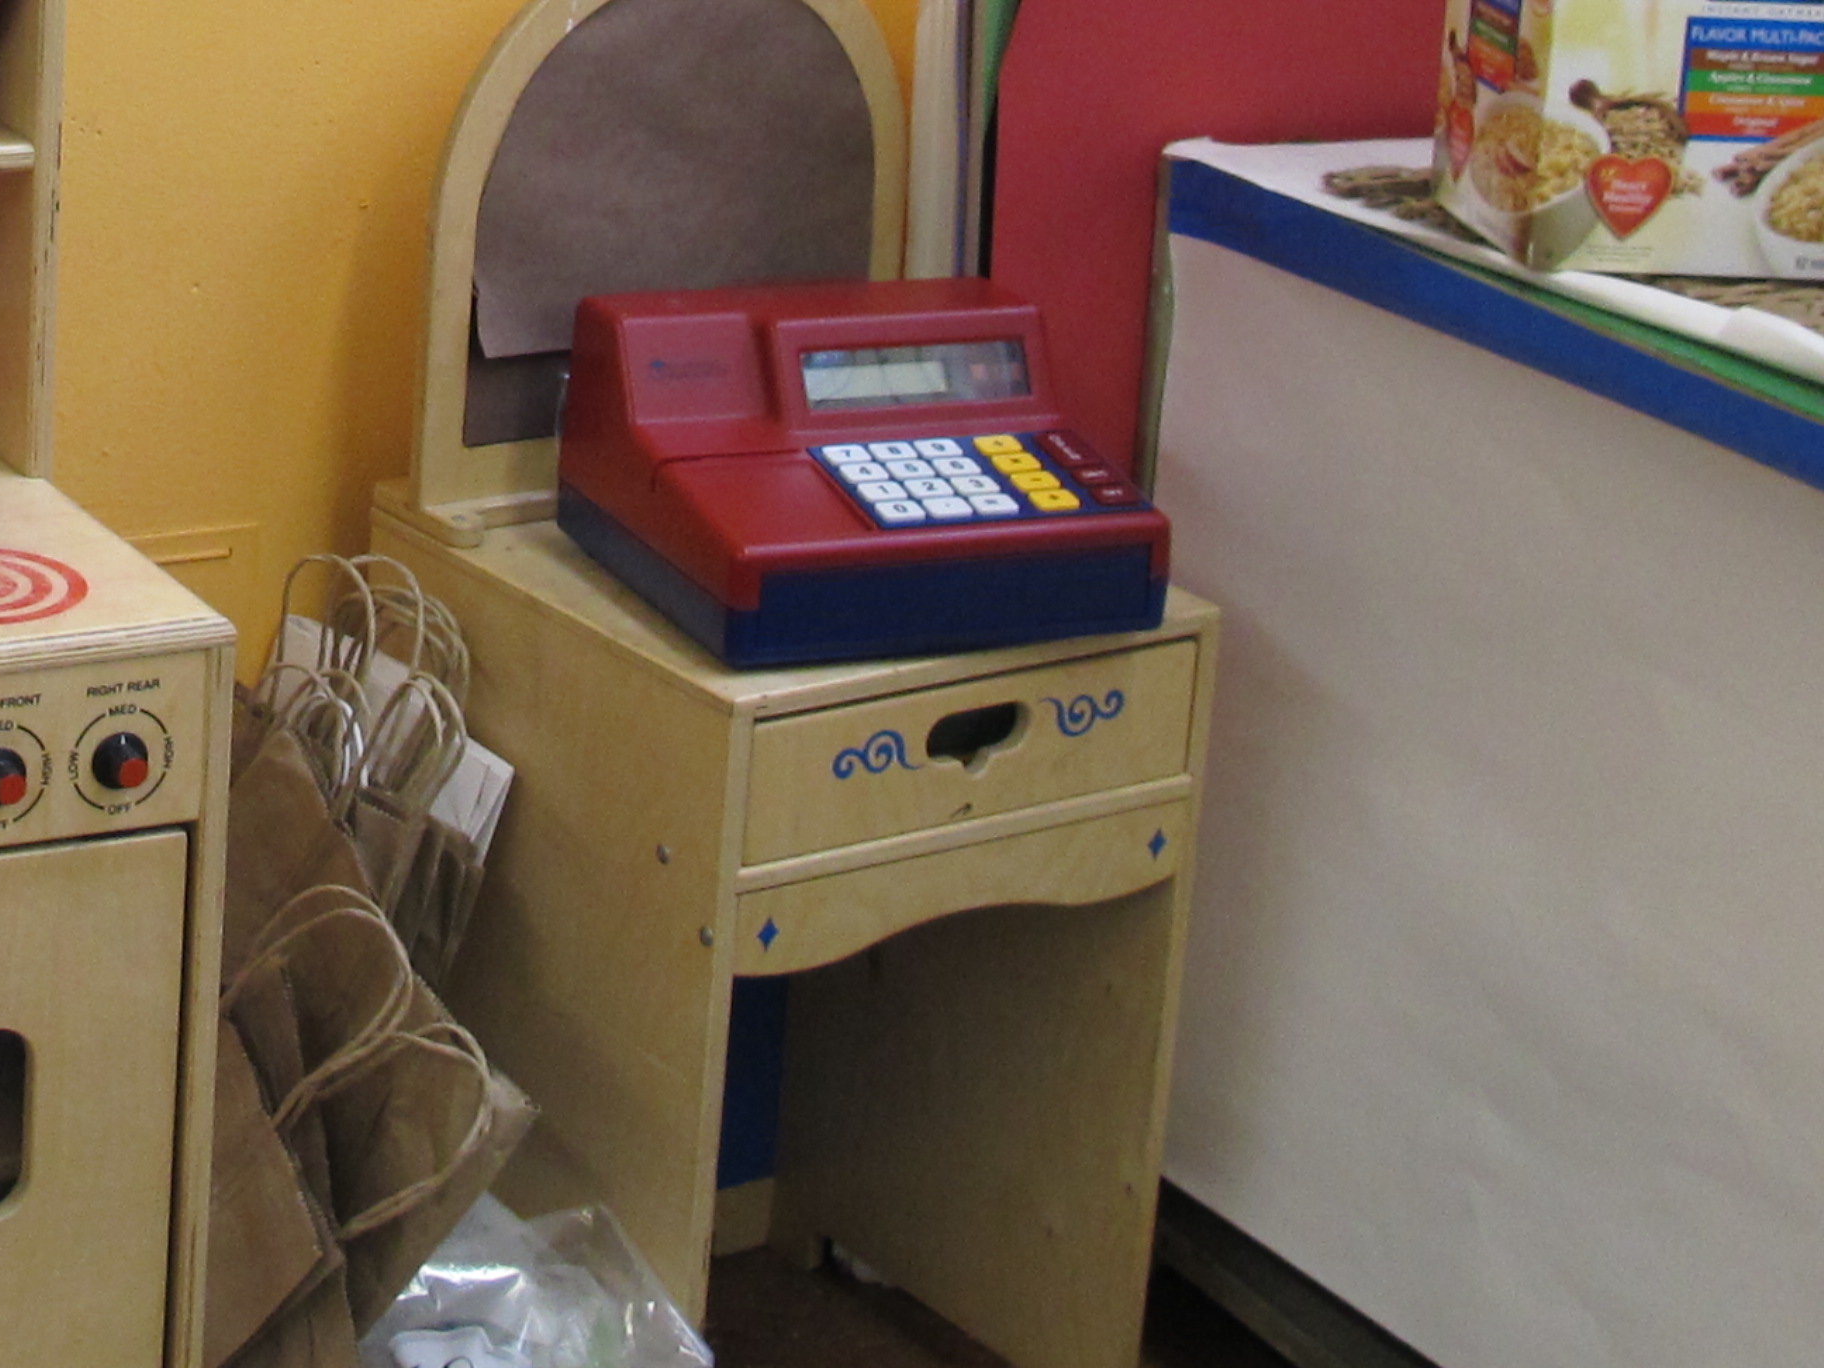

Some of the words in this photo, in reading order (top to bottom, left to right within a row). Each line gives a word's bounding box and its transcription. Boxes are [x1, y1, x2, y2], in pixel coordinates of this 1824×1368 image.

[932, 442, 945, 451] 9
[859, 466, 870, 476] 4
[923, 482, 936, 491] 2
[972, 478, 985, 488] 3
[893, 504, 907, 514] 0
[86, 683, 125, 698] RIGHT
[127, 678, 161, 693] REAR
[0, 694, 42, 709] FRONT
[108, 704, 137, 717] MED
[163, 735, 175, 769] HIGH
[41, 752, 53, 786] HIGH
[68, 750, 79, 782] LOW
[108, 803, 132, 816] OFF
